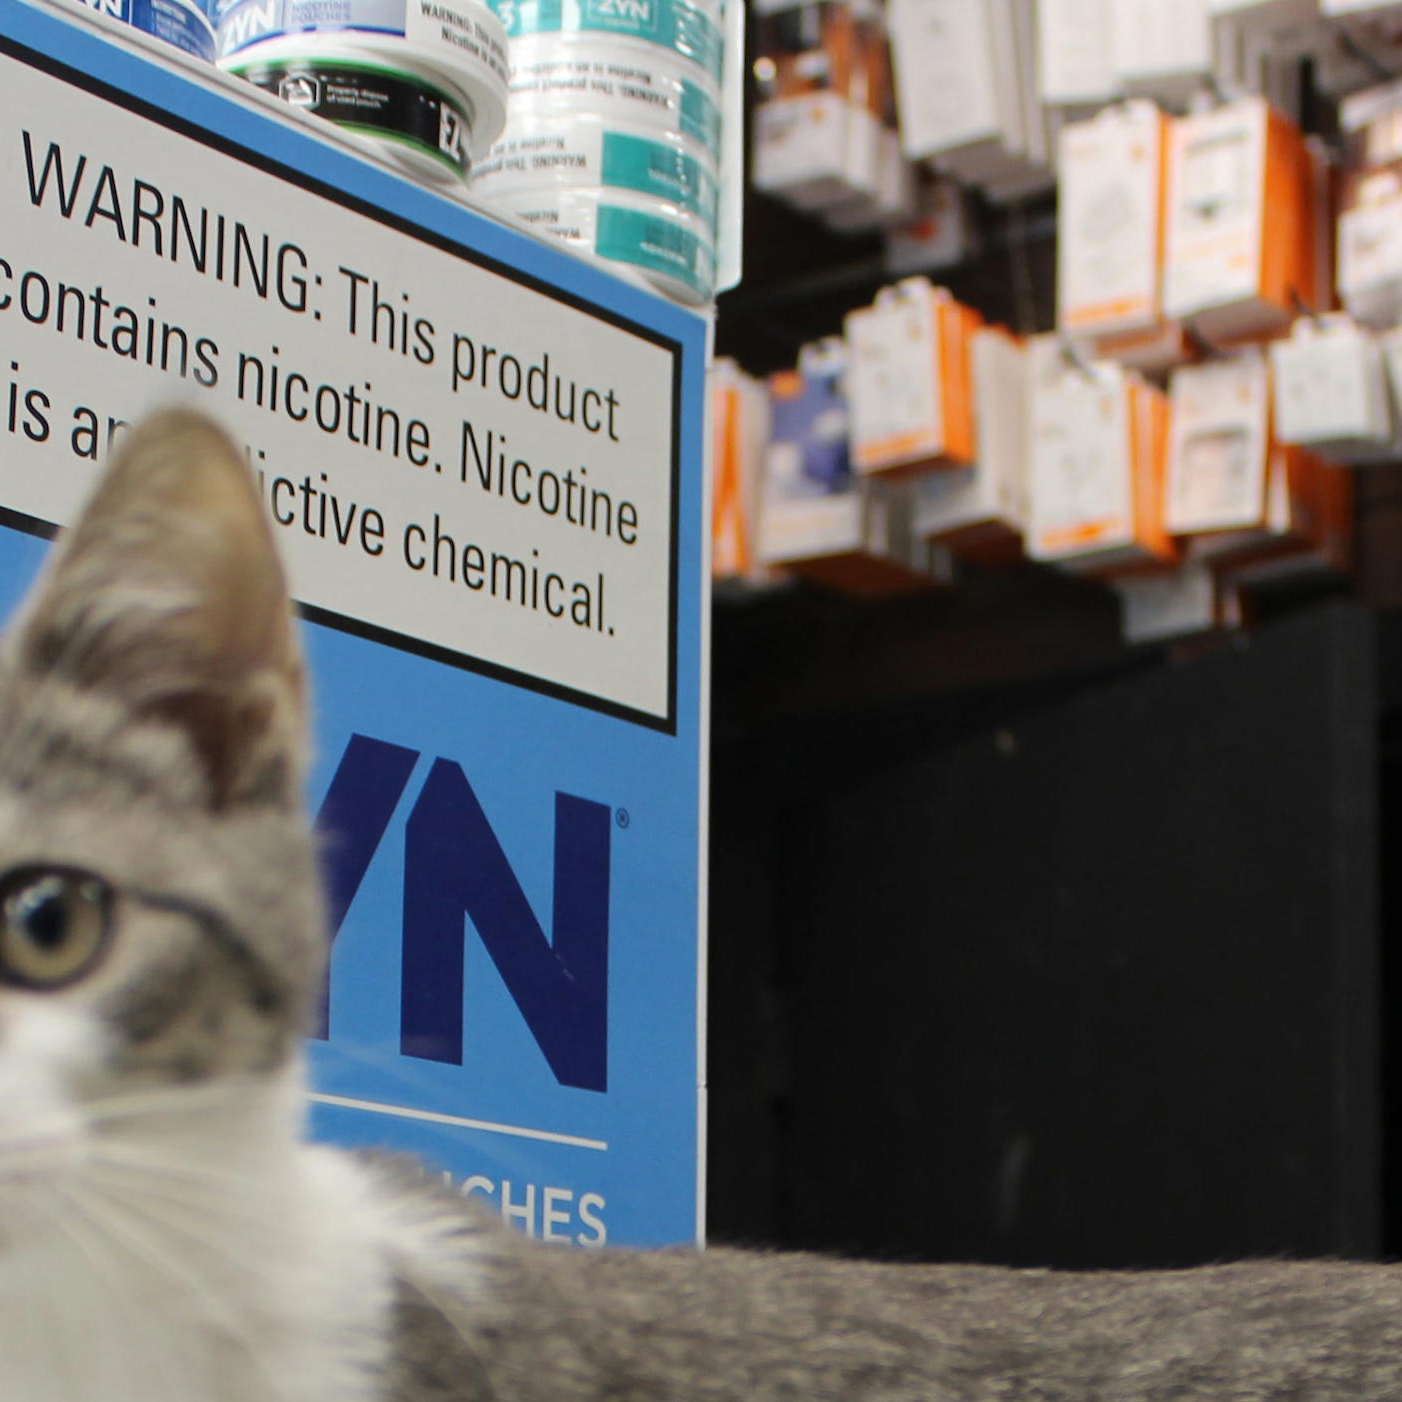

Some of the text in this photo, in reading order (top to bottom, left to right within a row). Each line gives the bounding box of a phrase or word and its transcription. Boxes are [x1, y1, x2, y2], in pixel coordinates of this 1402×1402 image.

[22, 130, 324, 321] WARNING:
[339, 266, 436, 366] This
[453, 328, 620, 443] product
[8, 362, 51, 442] is
[404, 517, 615, 637] chemical.
[238, 347, 443, 474] nicotine.
[463, 422, 639, 546] Nicotine
[304, 732, 612, 1094] YN
